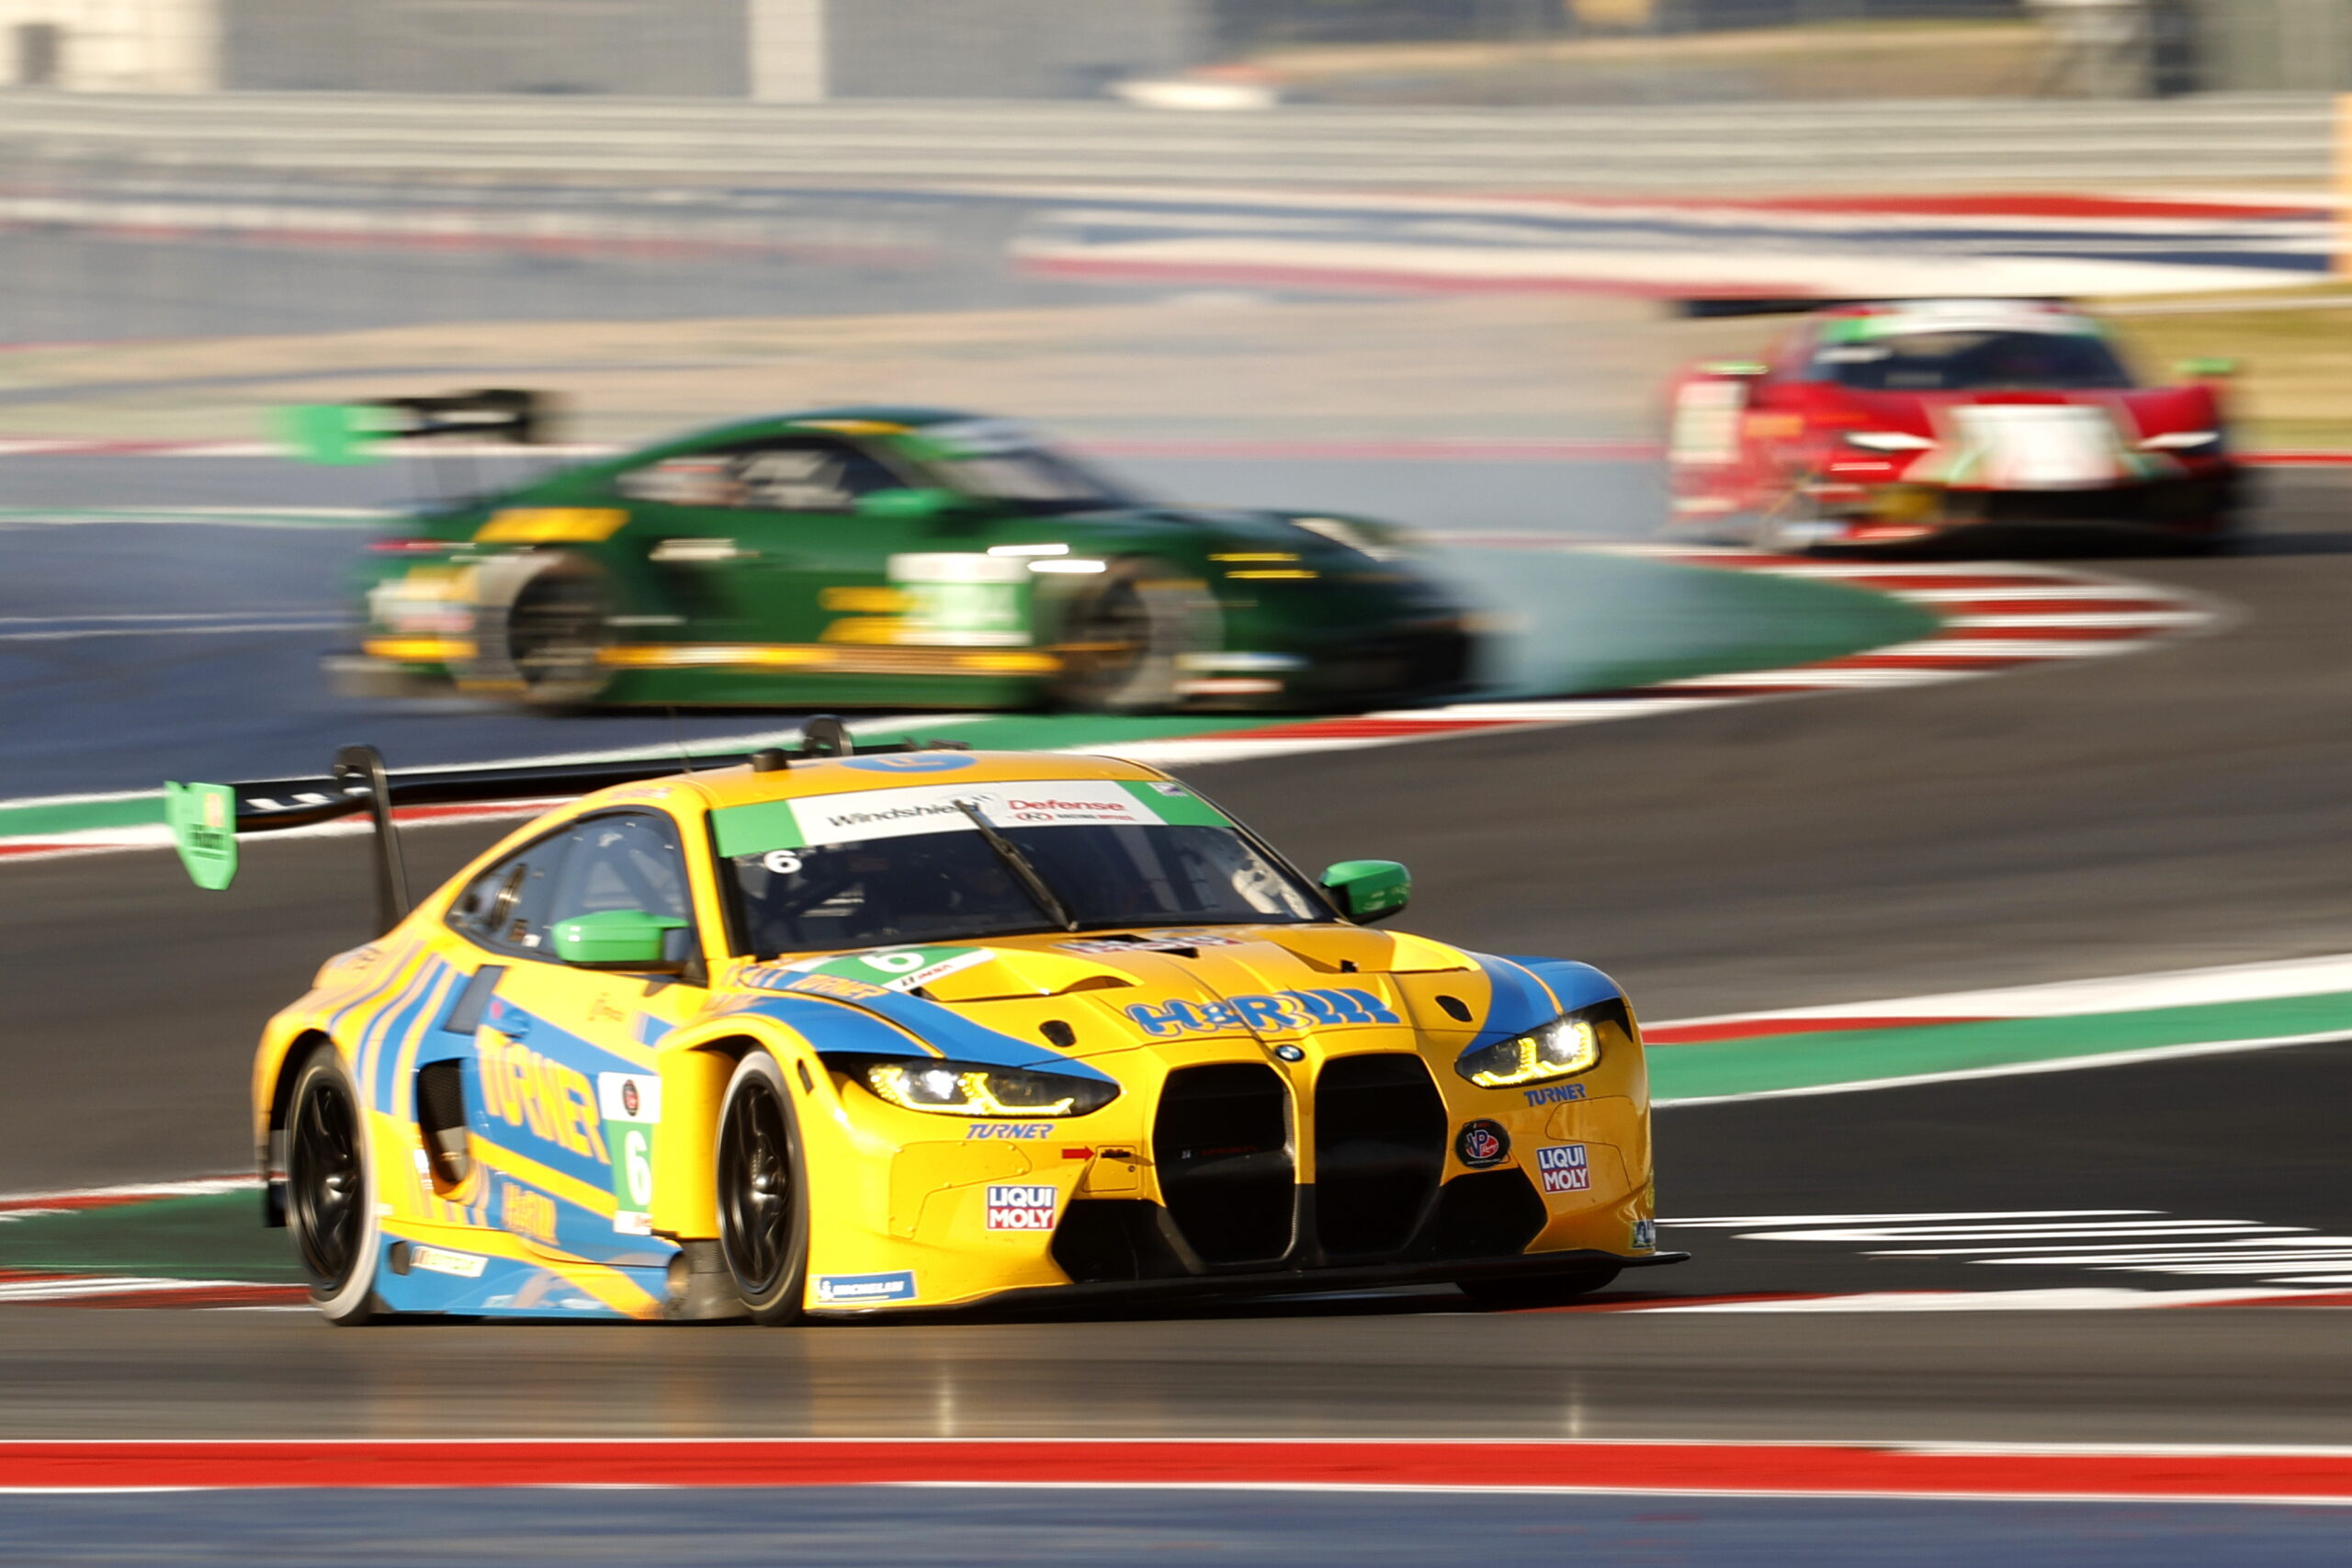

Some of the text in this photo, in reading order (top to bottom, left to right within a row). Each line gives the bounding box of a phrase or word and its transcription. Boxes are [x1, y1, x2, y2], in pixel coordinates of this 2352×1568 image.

[827, 799, 1125, 826] Windshie Defense
[763, 850, 803, 874] 6
[858, 952, 925, 973] 6
[475, 1024, 612, 1165] TURNER
[1523, 1083, 1588, 1107] TURNER
[966, 1123, 1054, 1139] TURNER
[624, 1130, 652, 1207] 6
[1537, 1146, 1585, 1169] LIQUI
[1544, 1168, 1589, 1191] MOLY
[989, 1187, 1053, 1207] LIQUI
[989, 1209, 1053, 1229] MOLY
